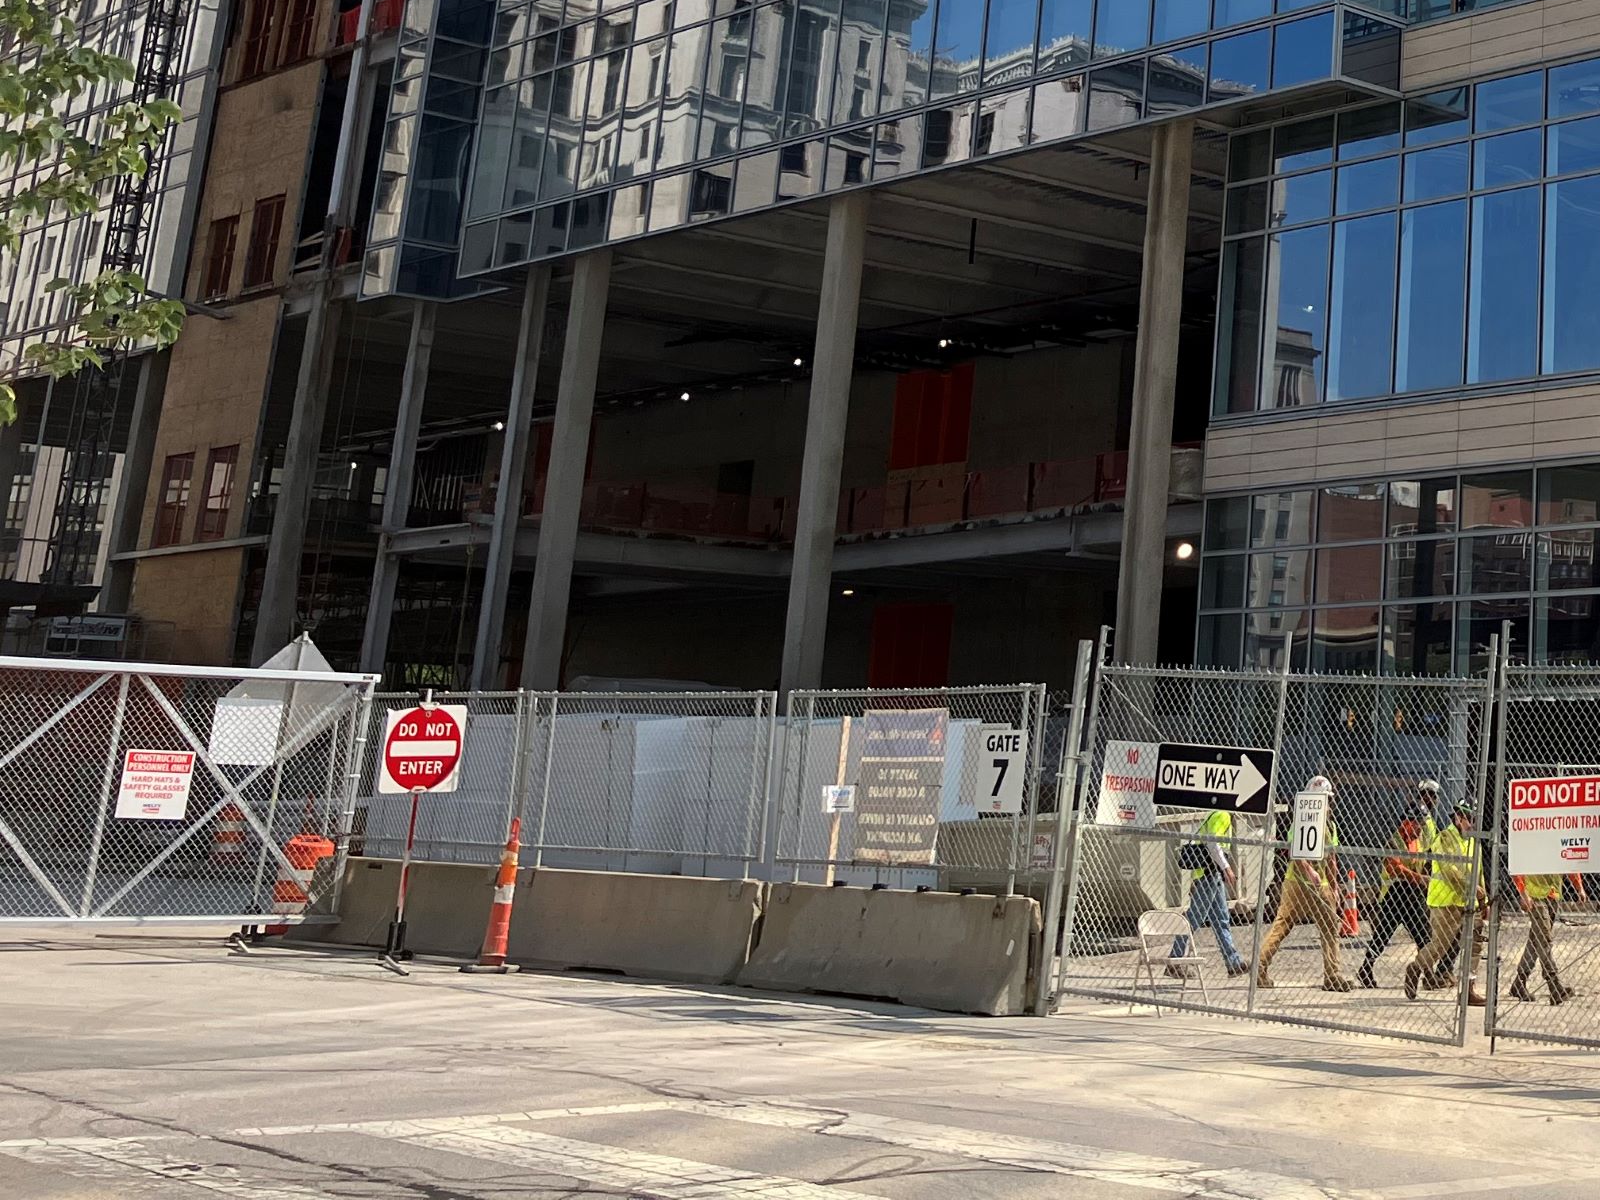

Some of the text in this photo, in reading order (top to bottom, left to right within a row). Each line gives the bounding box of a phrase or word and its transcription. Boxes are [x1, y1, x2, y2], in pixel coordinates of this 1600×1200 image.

[398, 722, 453, 737] DO NOT
[987, 735, 1020, 752] GATE
[133, 753, 188, 763] CONSTRUCTION
[1127, 749, 1139, 764] NO
[128, 762, 190, 773] PERSONNEL ONLY
[399, 760, 443, 775] ENTER
[991, 759, 1009, 796] 7
[1105, 775, 1155, 793] TRESPASSIN
[1162, 763, 1240, 790] ONE WAY
[153, 784, 185, 792] GLASSES
[1514, 785, 1540, 806] DO
[1544, 782, 1581, 804] NOT
[1299, 799, 1322, 810] SPEED
[1300, 812, 1319, 822] LIMIT
[1512, 815, 1578, 831] CONSTRUCTION
[1299, 826, 1317, 851] 10
[1560, 837, 1590, 846] WELTY
